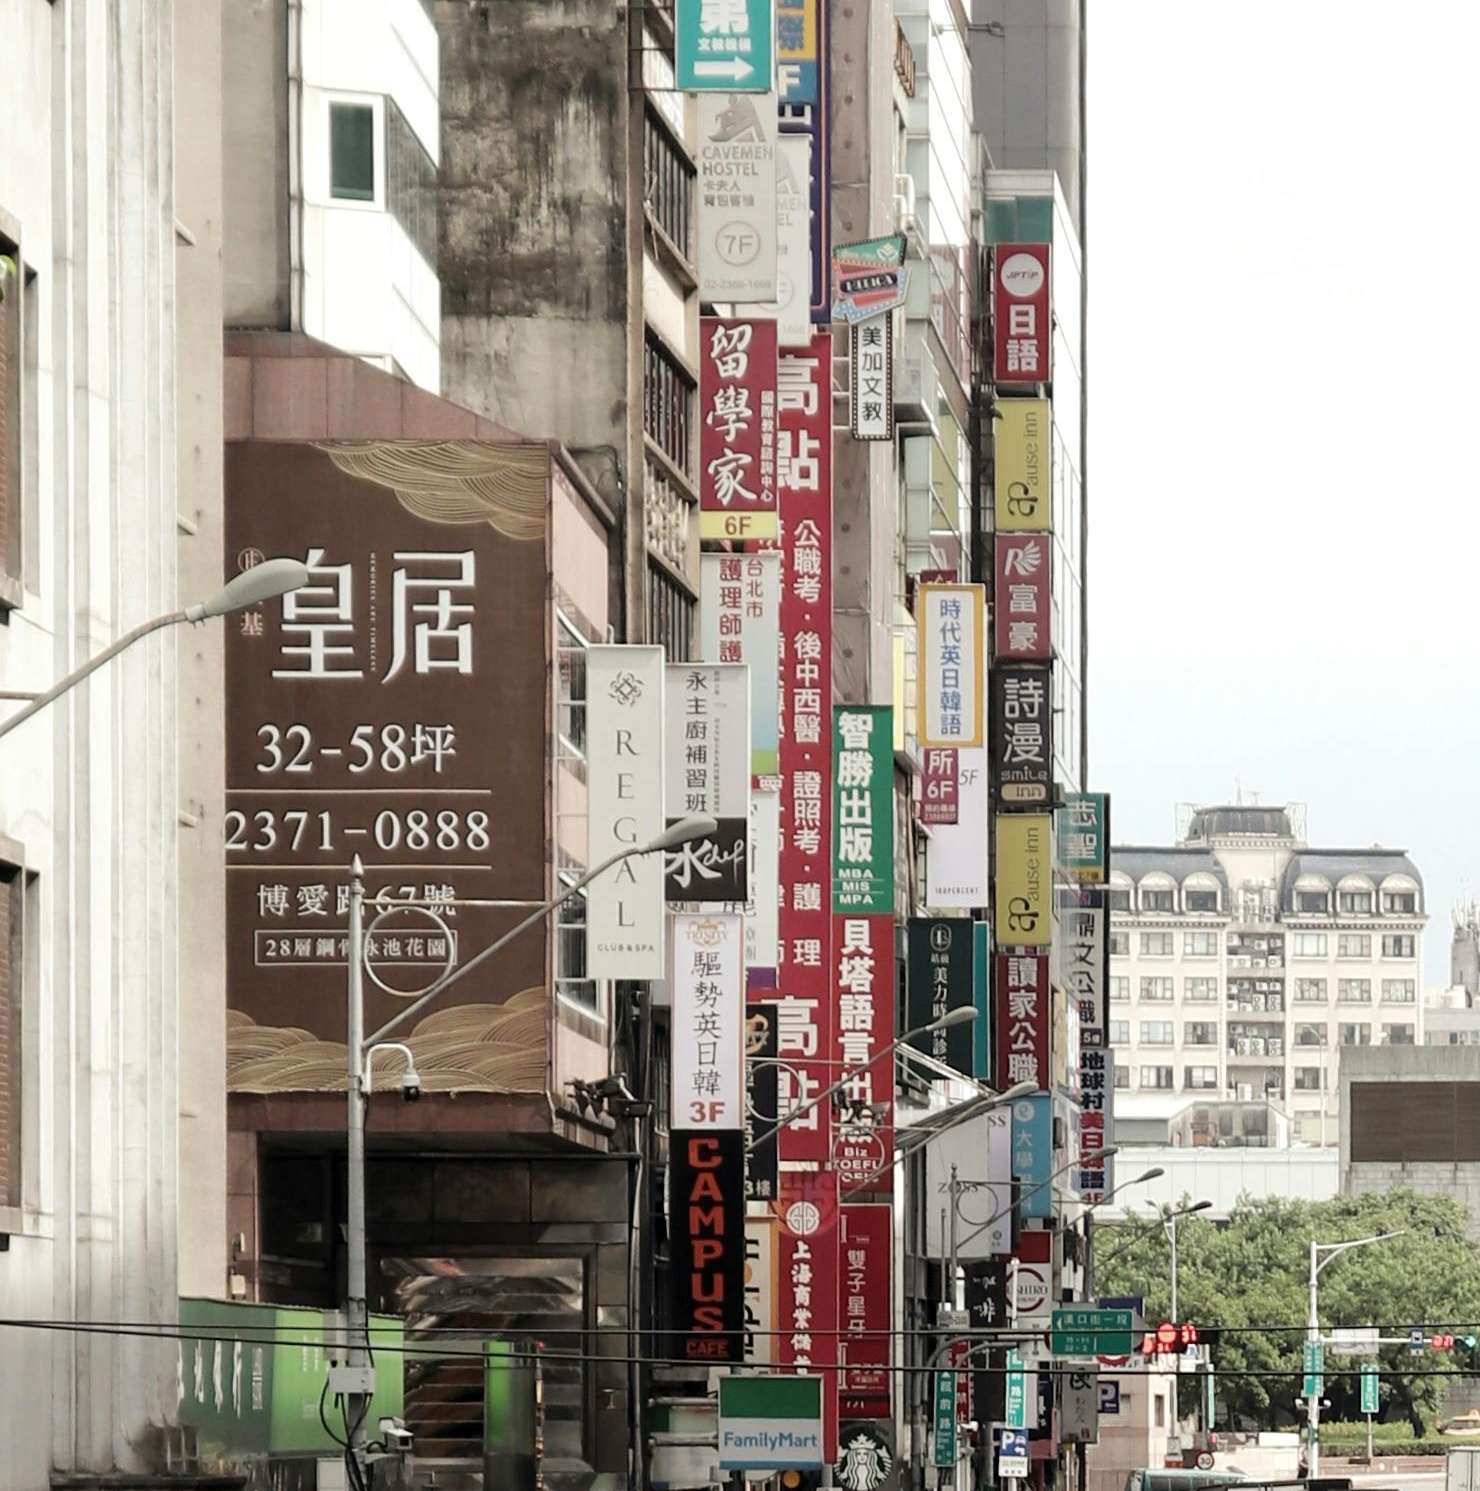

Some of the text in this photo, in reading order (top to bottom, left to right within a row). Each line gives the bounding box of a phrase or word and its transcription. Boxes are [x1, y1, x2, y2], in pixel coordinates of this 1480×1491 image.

[702, 146, 774, 159] CAVEMEN
[702, 161, 759, 176] HOSTEL
[703, 180, 742, 192] 卡夫人
[723, 235, 754, 255] 7F
[1006, 304, 1040, 372] 日語
[862, 325, 883, 422] 美加文教
[706, 323, 758, 506] 留學家
[778, 354, 821, 491] 高點
[724, 516, 752, 536] 6F
[272, 548, 477, 685] 皇居
[746, 560, 764, 619] 台北市
[1008, 583, 1038, 653] 富豪
[939, 599, 962, 736] 時代英日韓語
[685, 671, 708, 813] 永主廚補習班
[1002, 677, 1045, 764] 詩漫
[256, 724, 457, 773] 32-58坪
[837, 711, 874, 863] 智勝出版
[926, 781, 954, 799] 6F
[959, 768, 979, 787] 5F
[224, 810, 491, 851] 2371-0888
[612, 728, 640, 928] REGAL
[1066, 799, 1098, 860] 志聖
[838, 869, 874, 879] MBA
[838, 894, 874, 905] MPA
[842, 881, 870, 892] MIS
[691, 950, 723, 1097] 驅勢英日韓
[1007, 957, 1039, 1089] 讀家公職
[689, 1100, 725, 1123] 3F
[844, 1145, 868, 1158] Biz
[687, 1137, 725, 1332] CAMPUS
[686, 1341, 729, 1357] CAFE
[724, 1431, 818, 1452] FamilyMart
